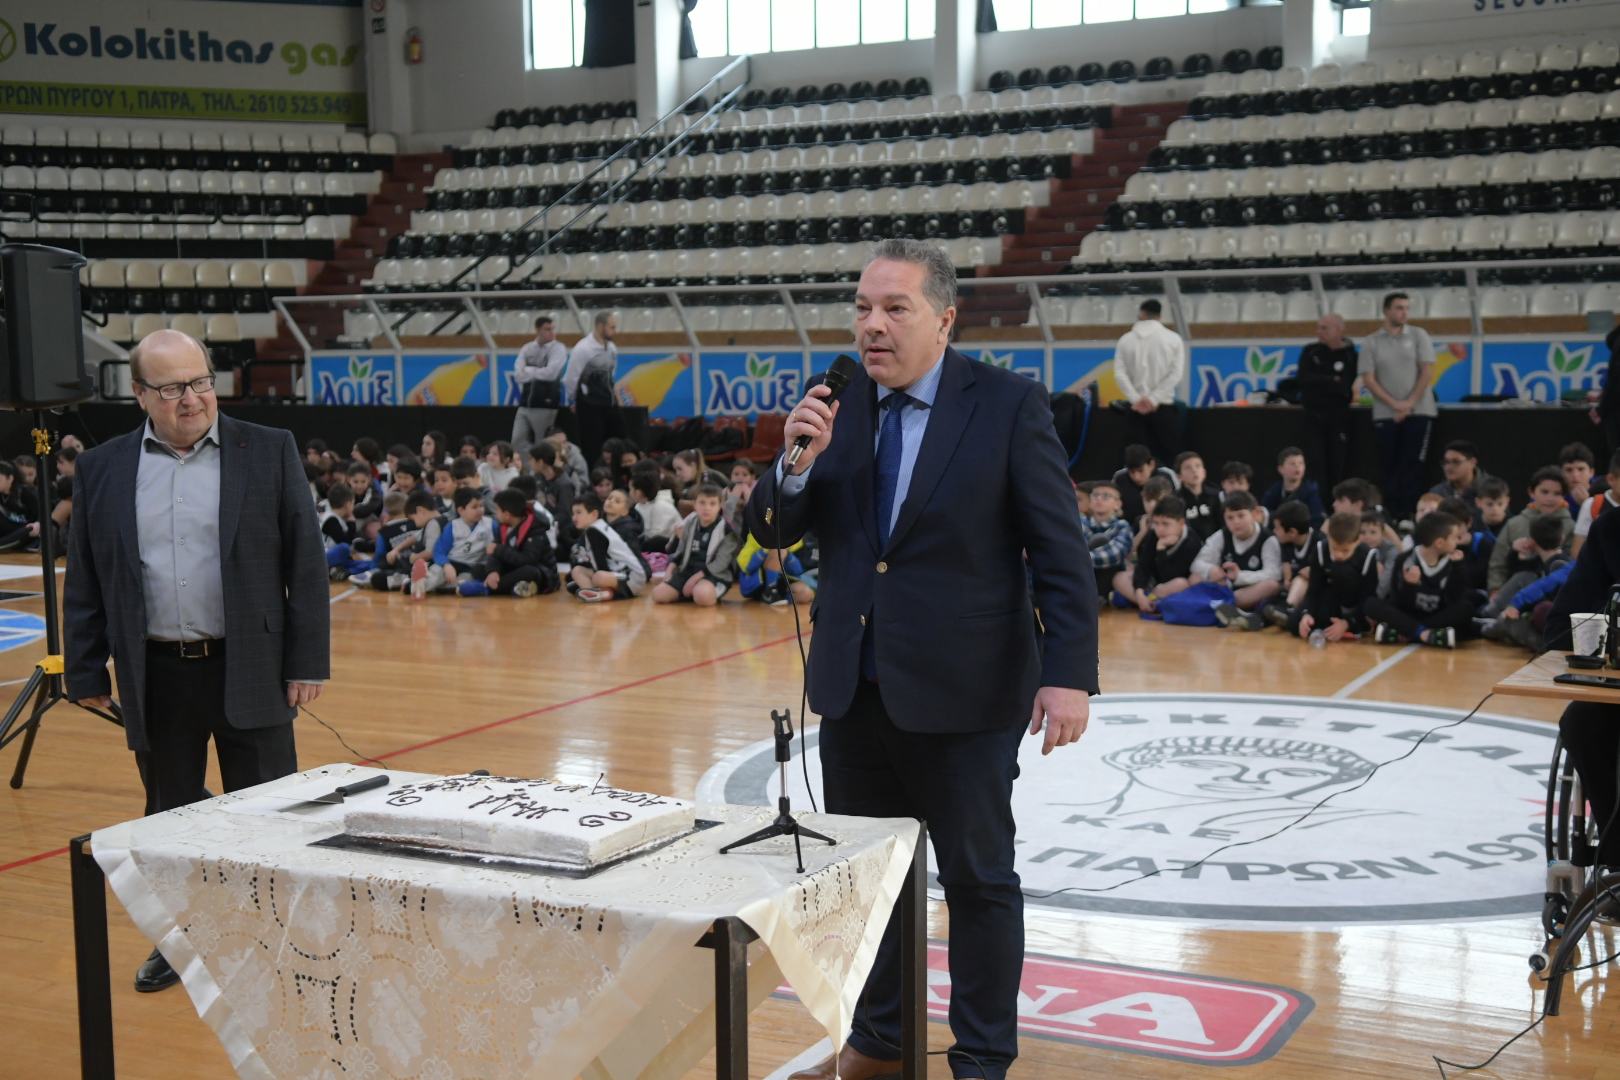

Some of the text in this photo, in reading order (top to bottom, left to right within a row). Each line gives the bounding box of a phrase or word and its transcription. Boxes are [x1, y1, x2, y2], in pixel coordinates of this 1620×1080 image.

[24, 22, 359, 75] Kolokithas gas
[47, 87, 114, 108] ΠΥΡΓΟΥ
[137, 90, 195, 112] ΠΑΤΡΑ,
[248, 94, 287, 113] 2610
[710, 371, 797, 412] λουξ
[1027, 847, 1440, 881] ΠΑΤΡΩΝ
